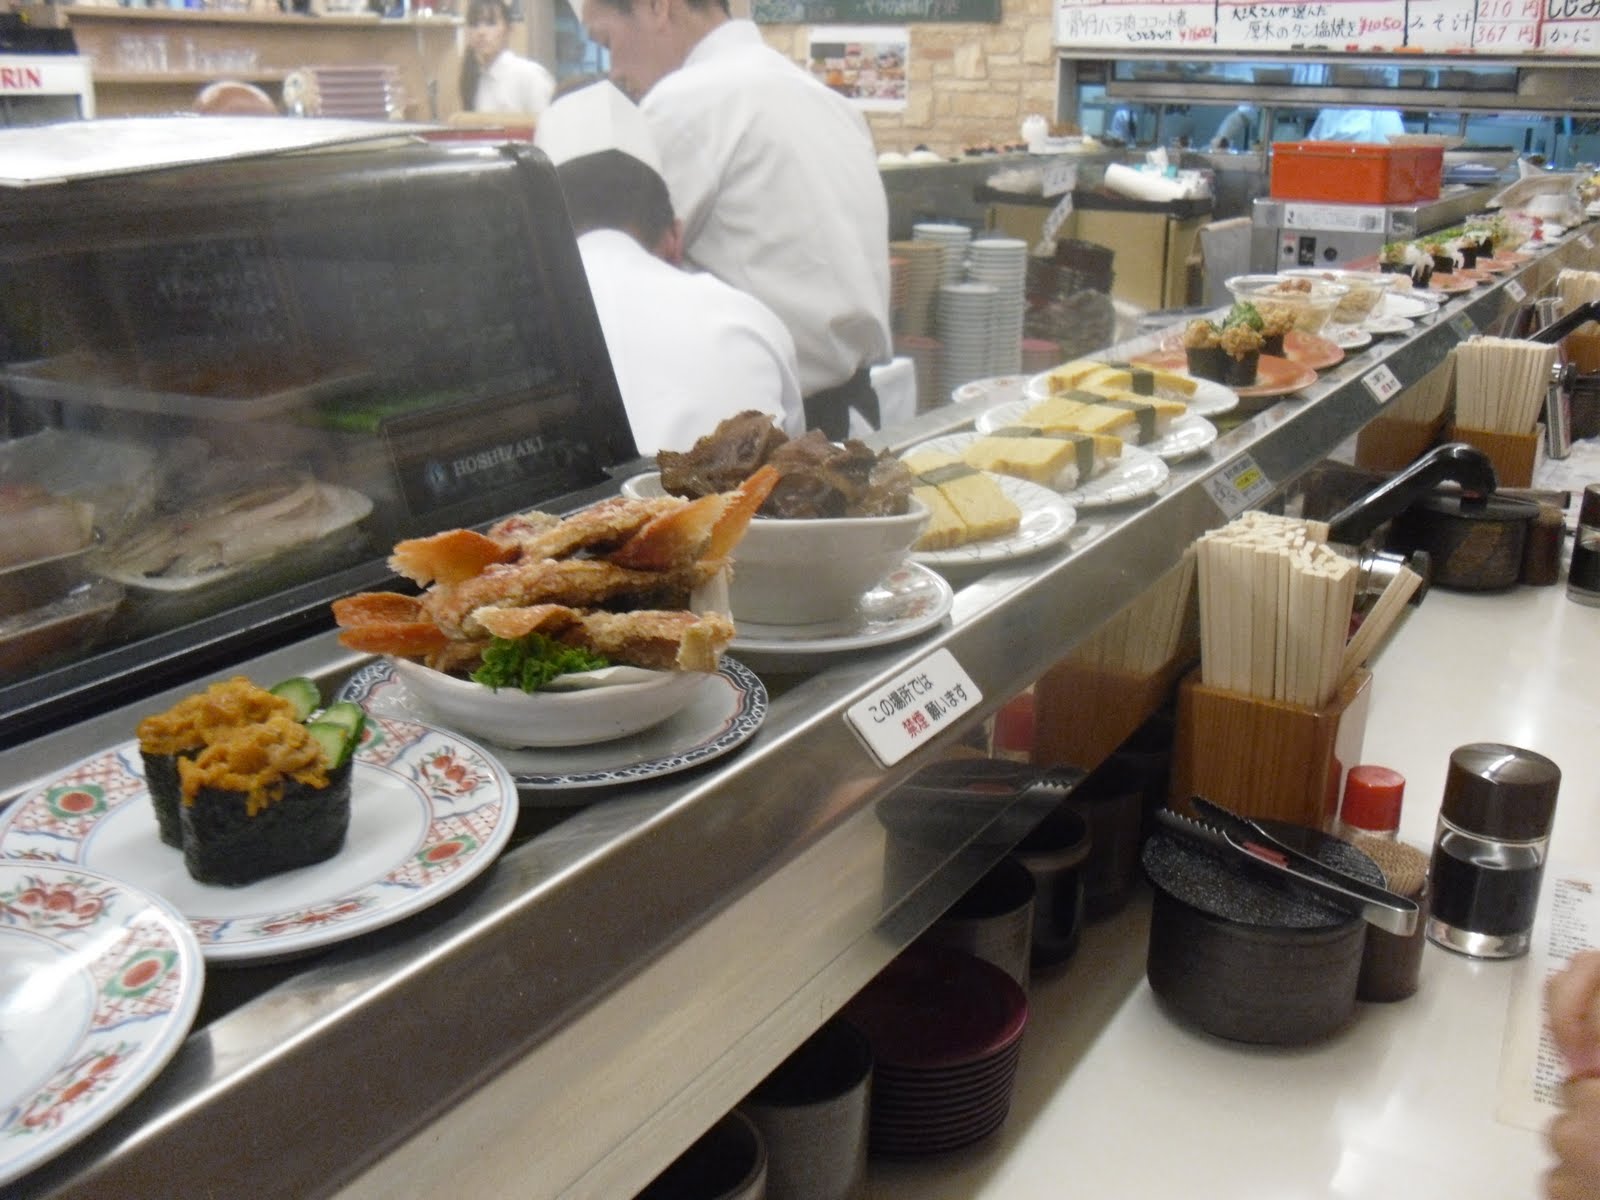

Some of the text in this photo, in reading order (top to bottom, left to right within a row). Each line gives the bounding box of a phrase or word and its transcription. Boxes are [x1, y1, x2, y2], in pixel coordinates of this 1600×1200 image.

[1410, 13, 1470, 32] みそ汁
[1550, 28, 1591, 43] かに
[453, 436, 544, 478] HOSHIZAKI
[868, 672, 934, 724] この場所では
[901, 683, 968, 739] 禁煙 願います
